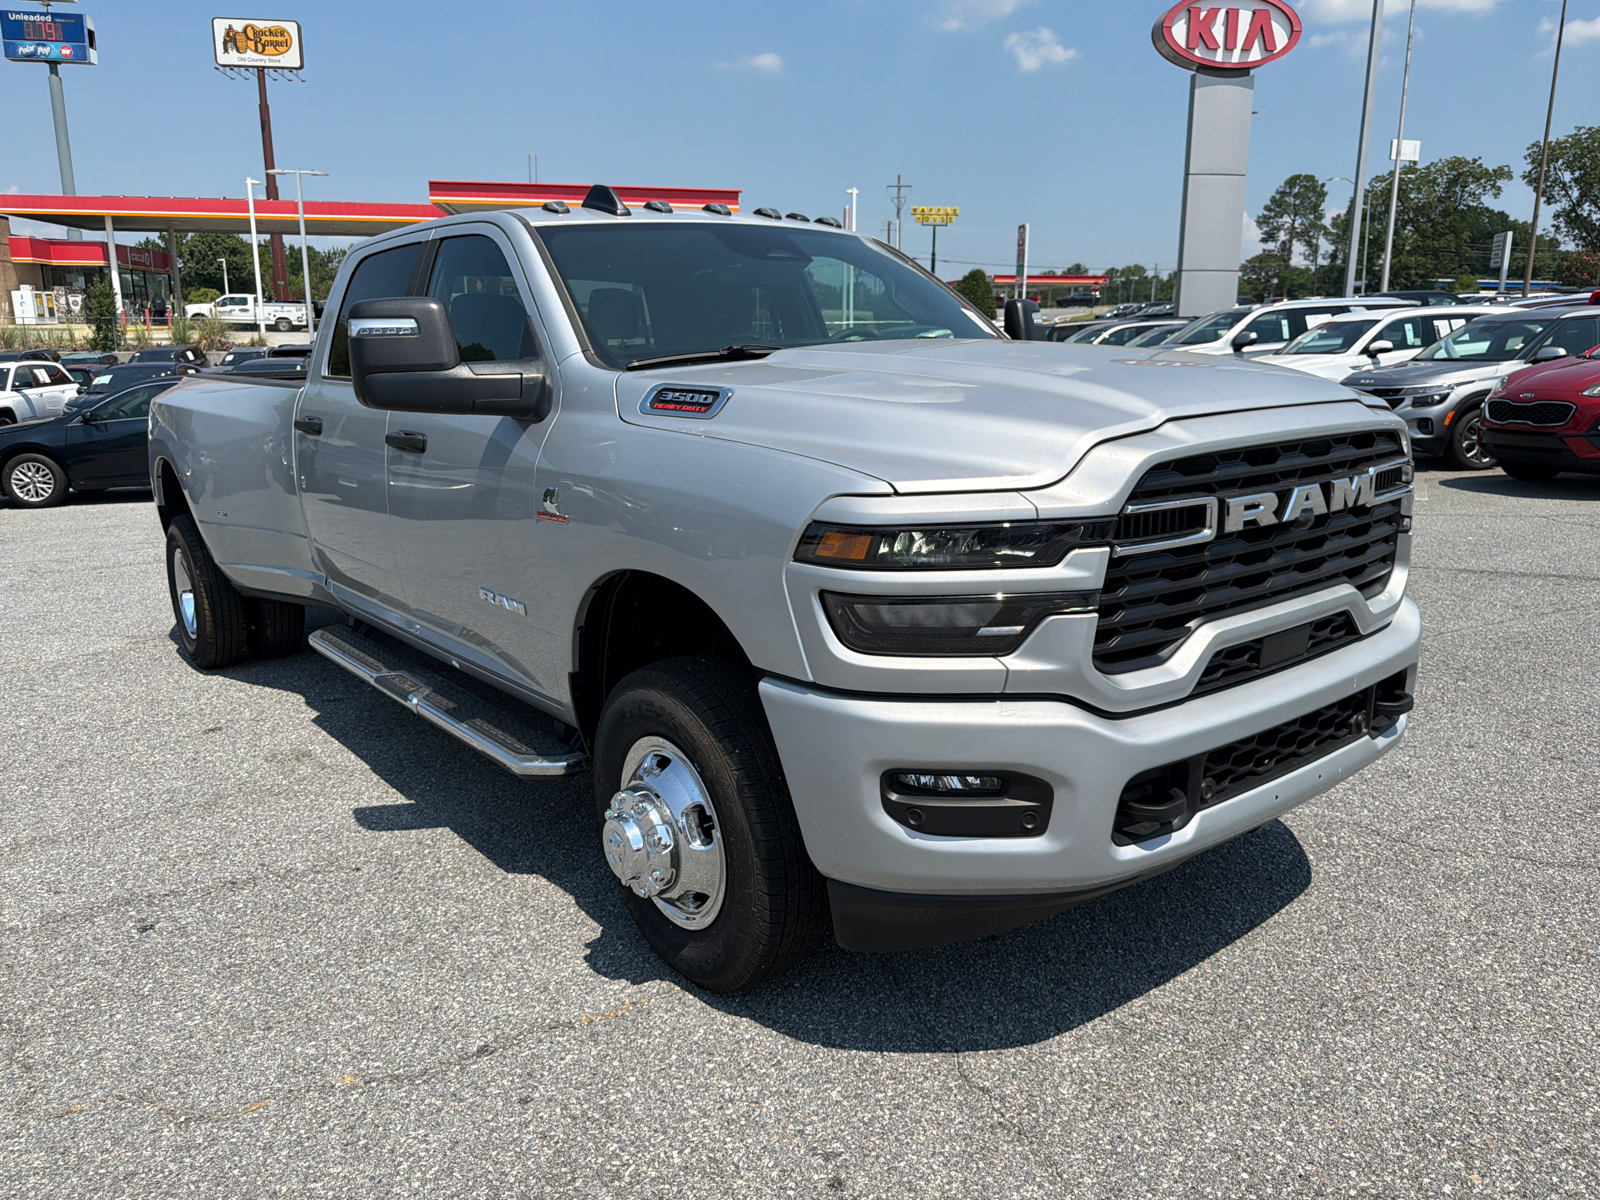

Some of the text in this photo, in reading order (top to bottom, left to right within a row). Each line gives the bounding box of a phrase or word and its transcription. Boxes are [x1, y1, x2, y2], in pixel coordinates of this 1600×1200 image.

[8, 13, 51, 21] Unleaded
[244, 25, 286, 41] Cracker
[1187, 6, 1277, 51] KIA
[18, 44, 51, 56] Polar Pop
[254, 37, 289, 54] Barrel
[912, 207, 958, 215] WAFFLE
[659, 391, 713, 403] 3500
[653, 403, 708, 412] HEAVY DUTY
[1225, 473, 1374, 533] RAM
[479, 587, 528, 616] RAM
